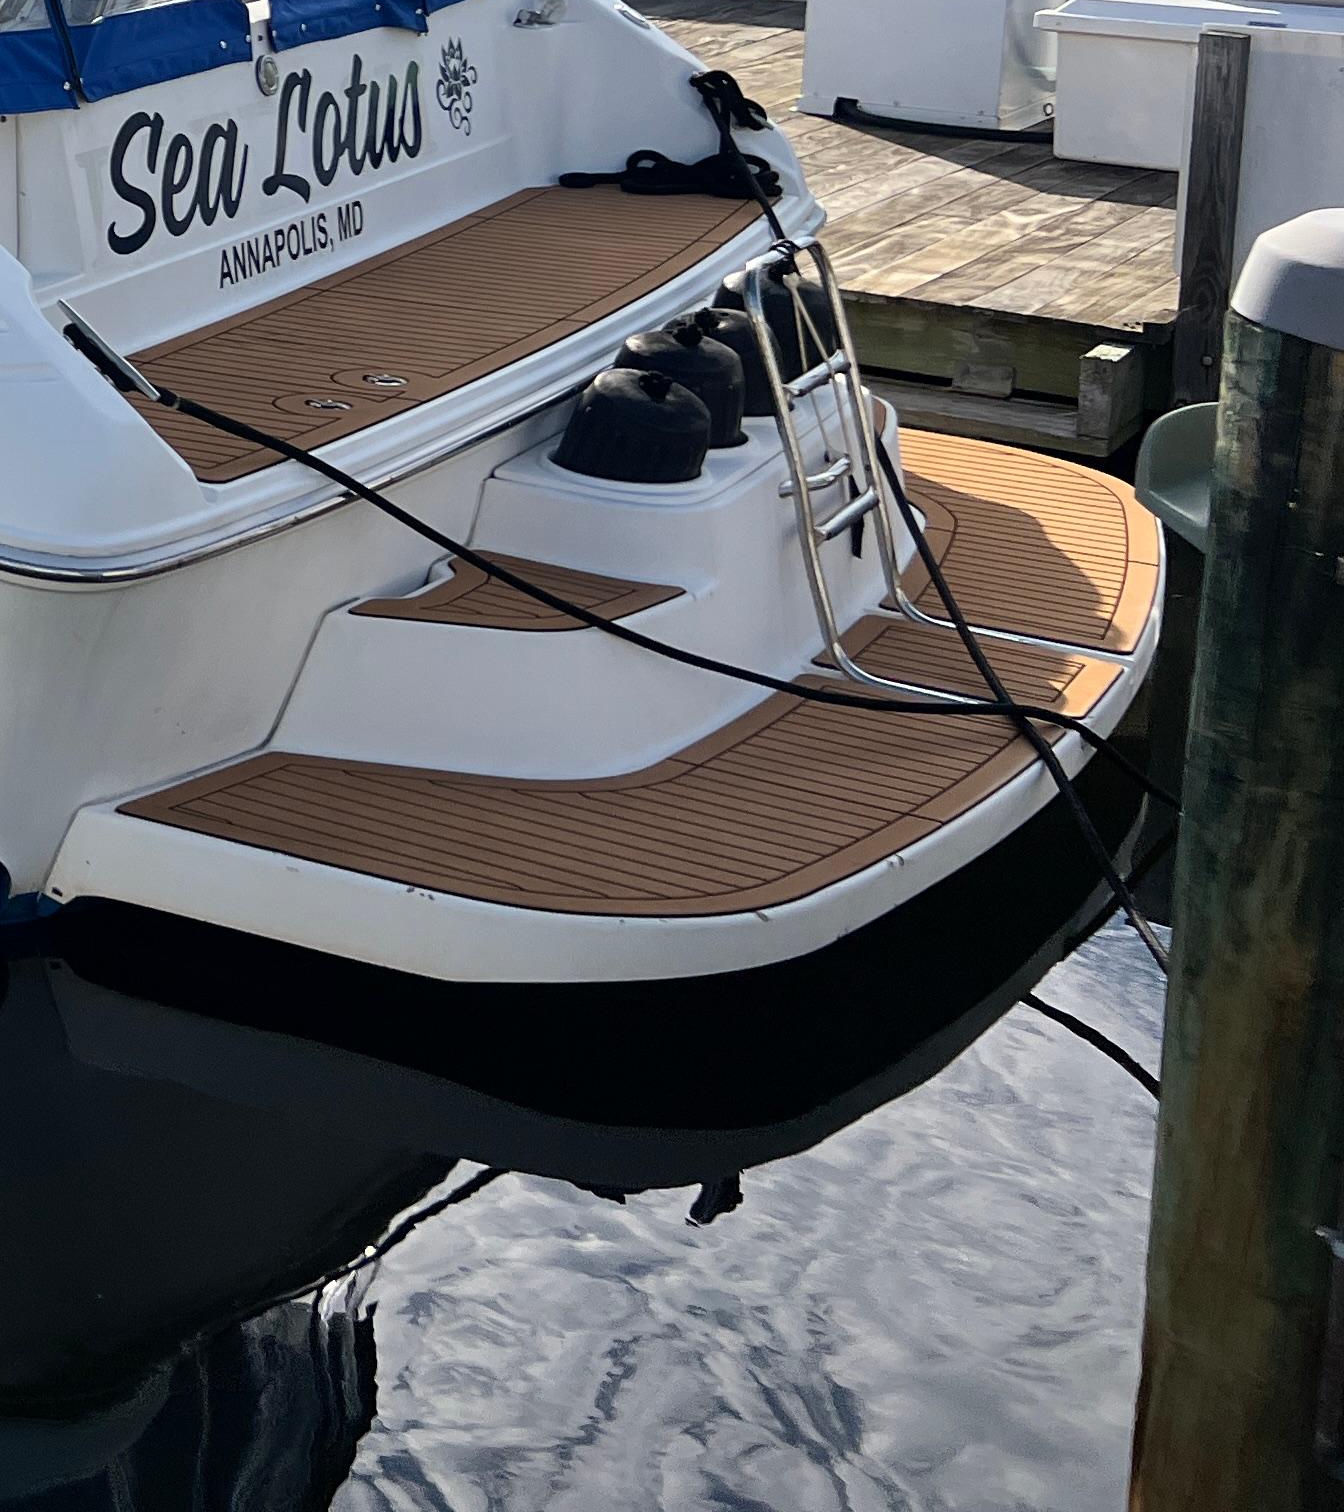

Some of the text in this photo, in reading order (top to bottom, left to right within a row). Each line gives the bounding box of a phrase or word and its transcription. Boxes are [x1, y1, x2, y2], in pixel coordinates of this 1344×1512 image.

[108, 53, 422, 255] Sea Lotus
[219, 200, 365, 290] ANNAPOLIS, MD
